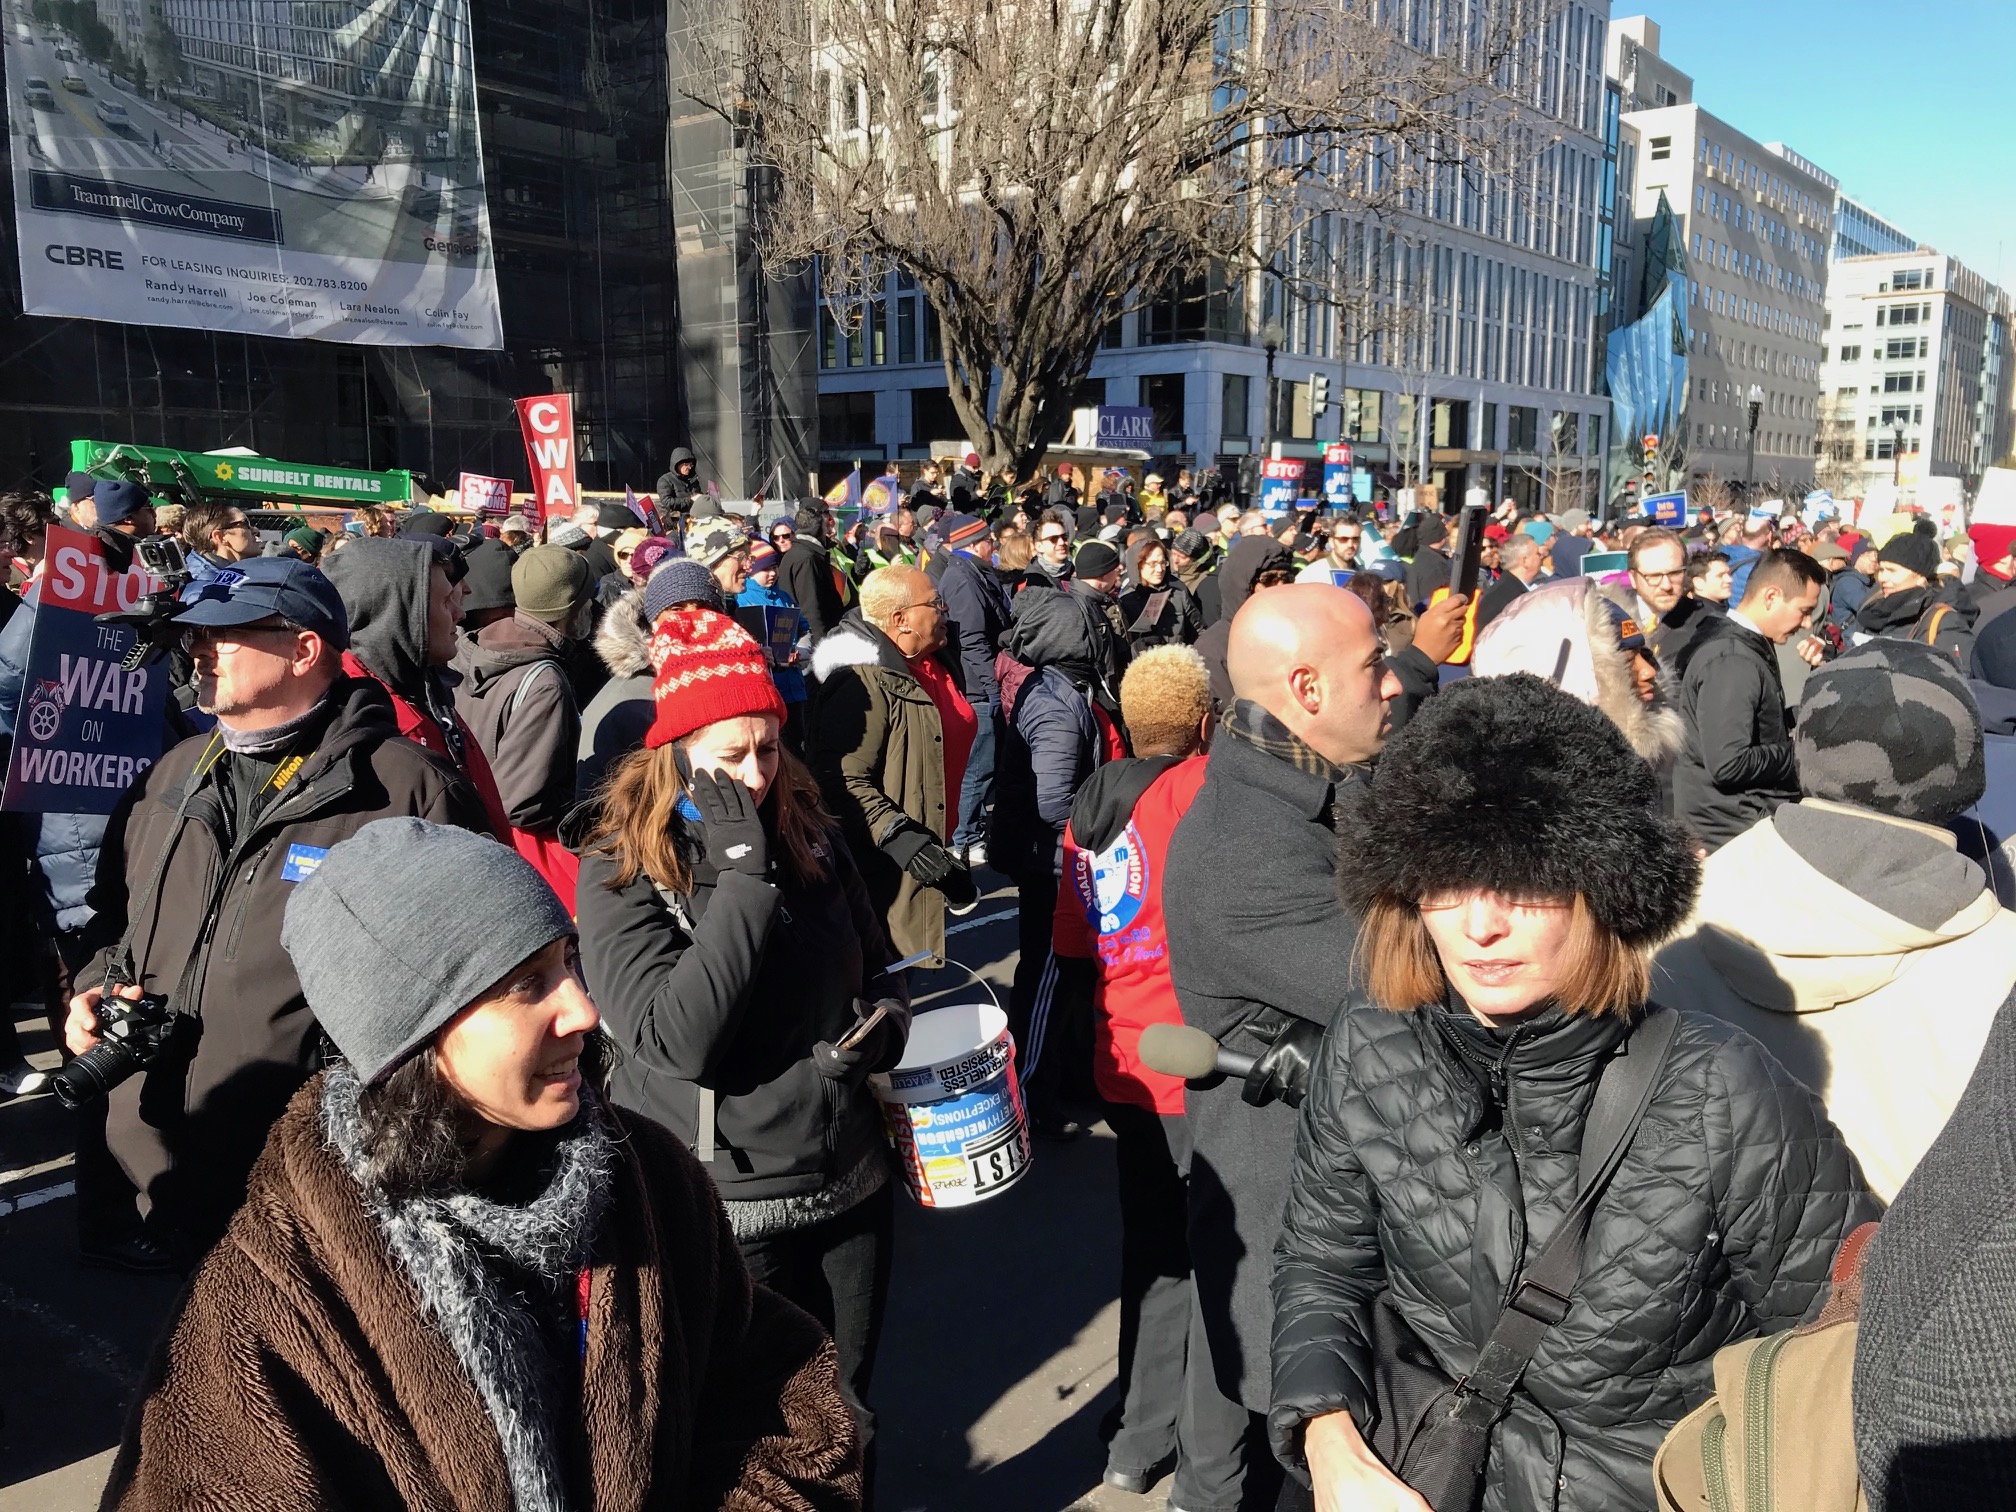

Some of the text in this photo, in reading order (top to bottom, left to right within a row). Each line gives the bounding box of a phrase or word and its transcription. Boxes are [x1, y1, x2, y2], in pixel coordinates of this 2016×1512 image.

[45, 244, 125, 271] CBRE
[142, 255, 368, 292] FOR LEASING INQUIRIES: 202.783.8200
[145, 279, 227, 298] Randy Harrell
[247, 292, 317, 309] Joe Coleman
[340, 301, 400, 315] Lara Nealon
[425, 308, 469, 321] Colin Fay
[1098, 415, 1152, 438] CLARK
[530, 402, 573, 505] CWA
[1098, 439, 1152, 448] CONSTRUCTION
[237, 466, 381, 493] SUNBELT RENTALS
[96, 626, 124, 652] THE
[60, 653, 148, 715] WAR
[81, 719, 104, 743] ON
[272, 755, 304, 791] Nikon
[937, 1046, 995, 1081] PERSISTED.
[893, 1075, 919, 1089] ACLU
[933, 1093, 1001, 1126] EXCEPTIONS)
